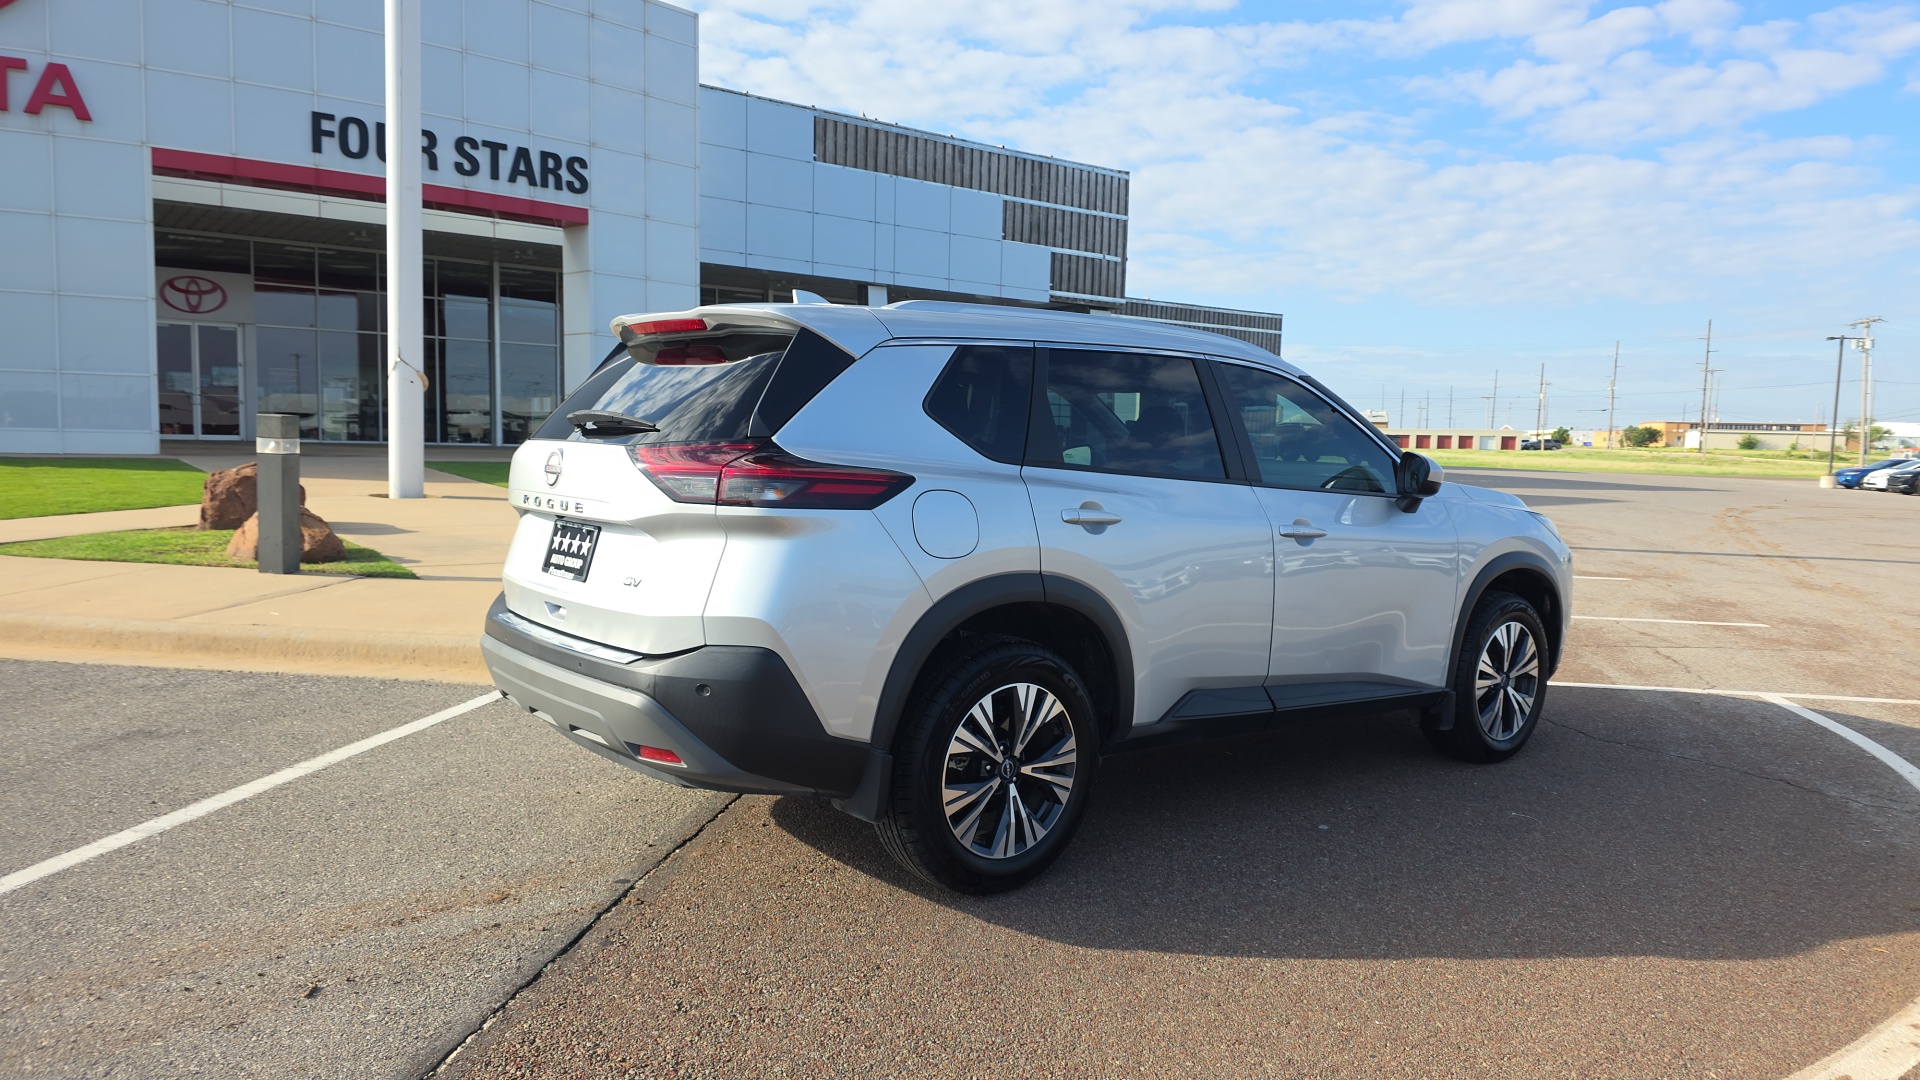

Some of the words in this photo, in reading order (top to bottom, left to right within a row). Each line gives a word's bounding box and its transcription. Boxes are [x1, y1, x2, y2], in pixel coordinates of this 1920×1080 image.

[454, 136, 589, 194] STARS
[523, 494, 583, 513] ROGUE
[623, 577, 642, 587] SV
